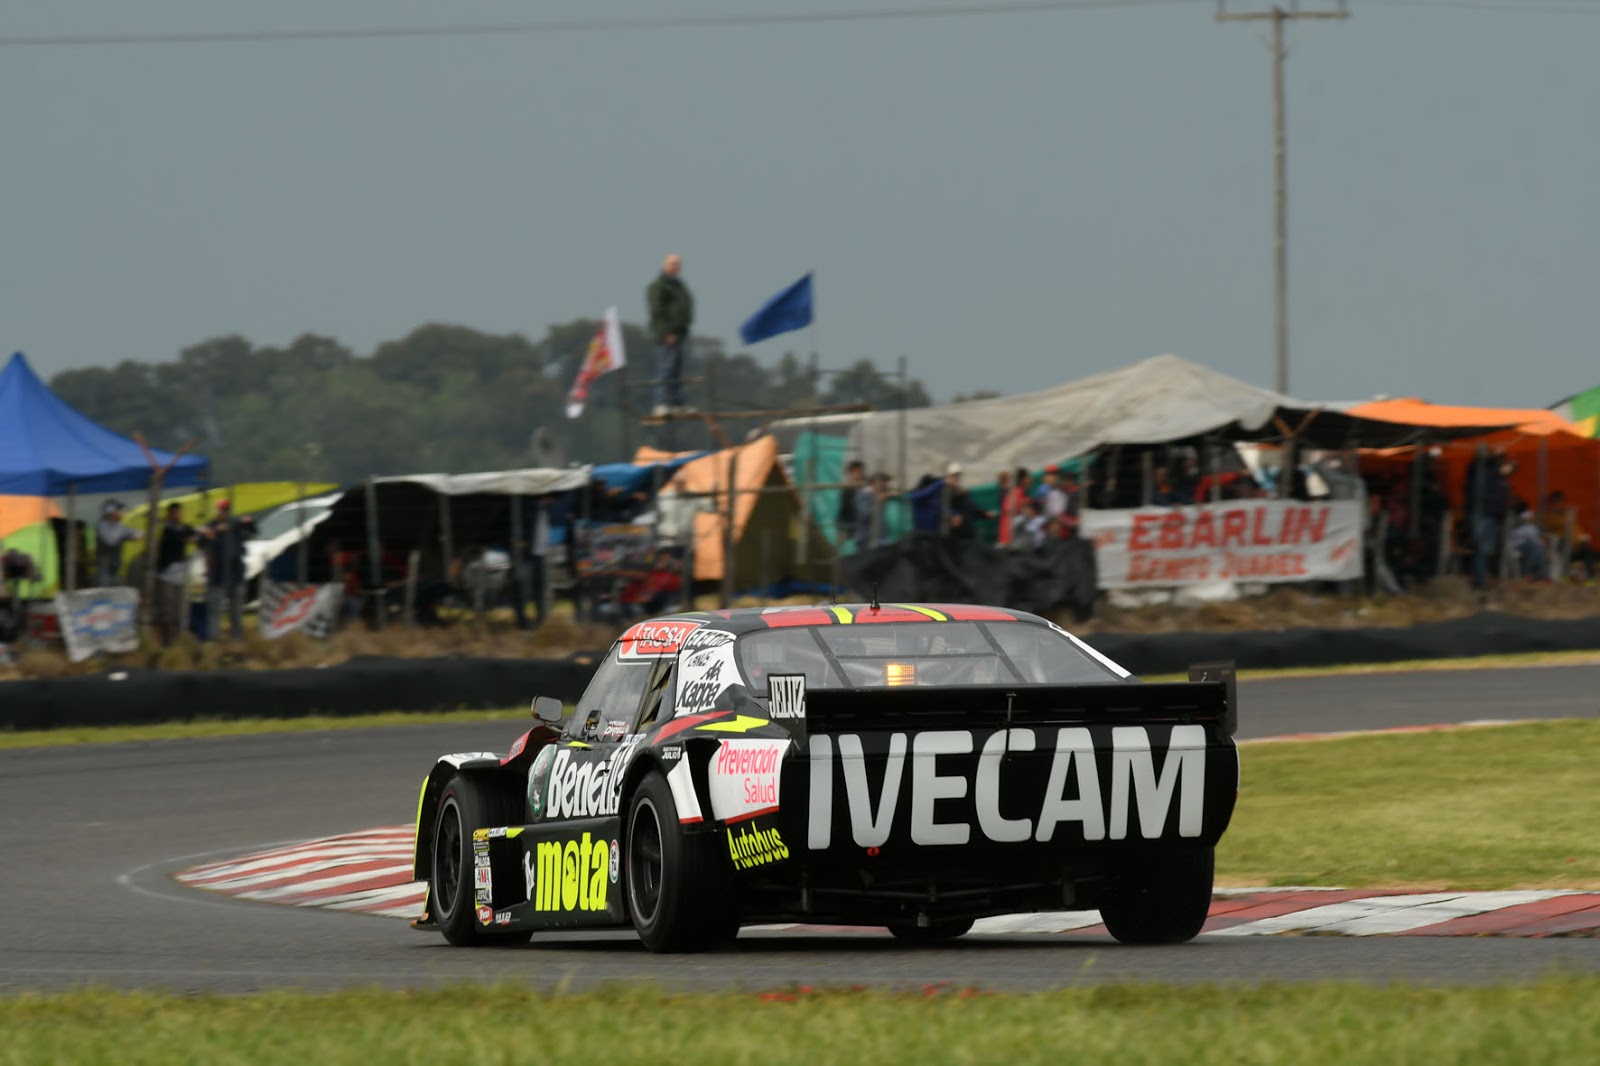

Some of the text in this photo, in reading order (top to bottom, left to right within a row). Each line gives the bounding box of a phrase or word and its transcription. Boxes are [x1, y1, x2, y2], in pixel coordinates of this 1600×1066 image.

[769, 676, 806, 719] JELUZ
[744, 776, 777, 804] Salud
[808, 725, 1206, 850] IVECAM
[727, 821, 790, 870] Autobus
[535, 832, 610, 911] mota
